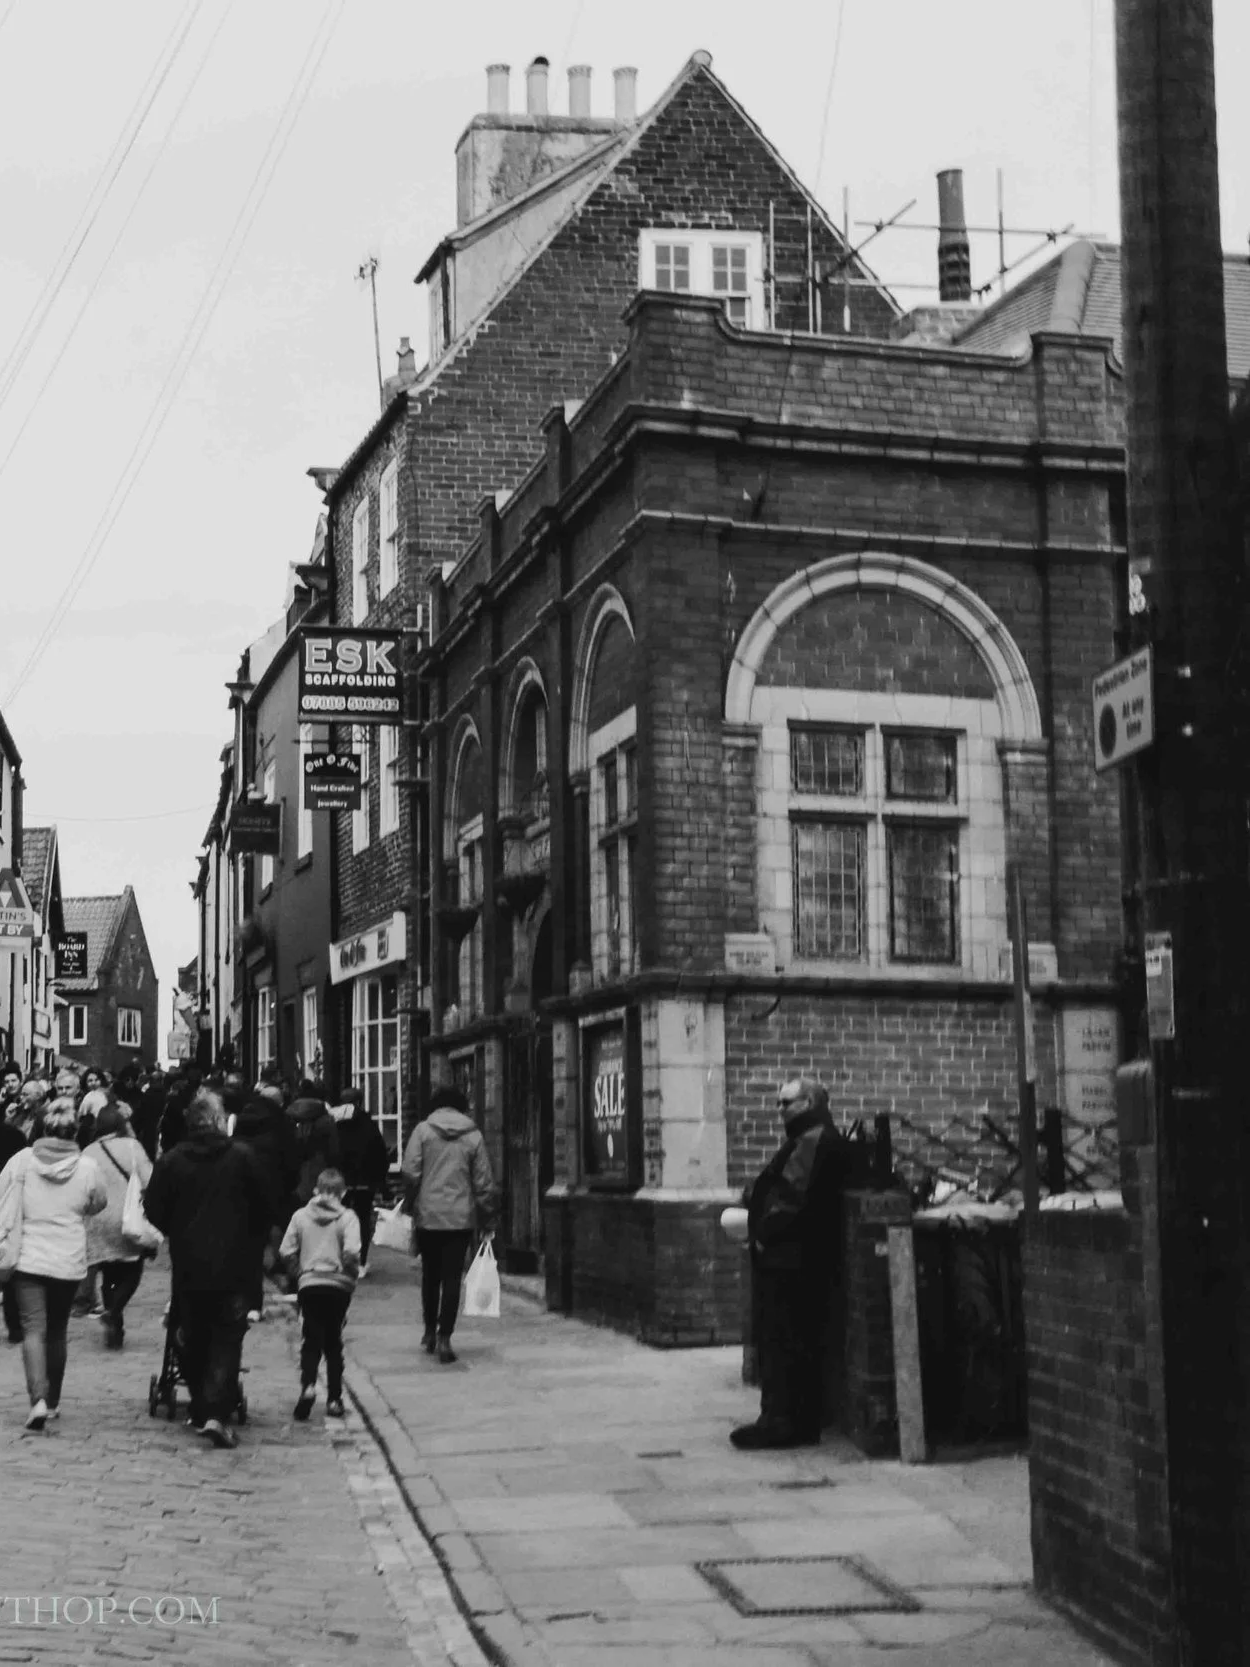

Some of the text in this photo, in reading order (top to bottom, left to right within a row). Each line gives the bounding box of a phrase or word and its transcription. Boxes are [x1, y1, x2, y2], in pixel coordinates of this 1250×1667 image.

[305, 638, 397, 673] ESK
[305, 673, 396, 687] SCAFFOLDING
[310, 784, 354, 792] Hand Crafted
[7, 924, 24, 935] BY
[594, 1072, 625, 1118] SALE
